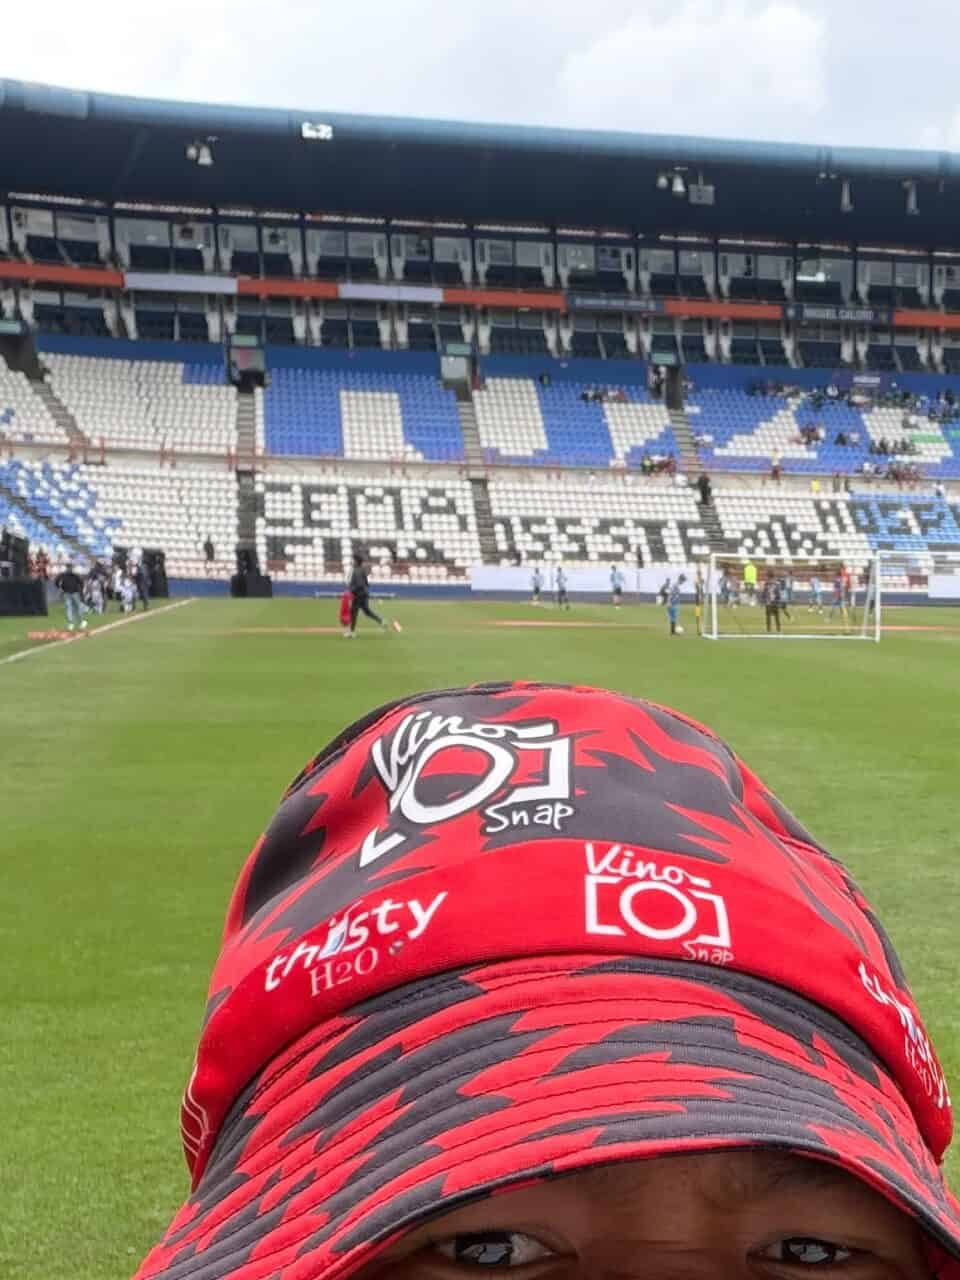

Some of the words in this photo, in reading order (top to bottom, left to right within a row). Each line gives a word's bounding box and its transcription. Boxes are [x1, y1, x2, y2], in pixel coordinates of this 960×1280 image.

[372, 711, 553, 791] Vino
[485, 802, 573, 832] Snap
[585, 842, 711, 888] Vino
[682, 942, 734, 965] Snap
